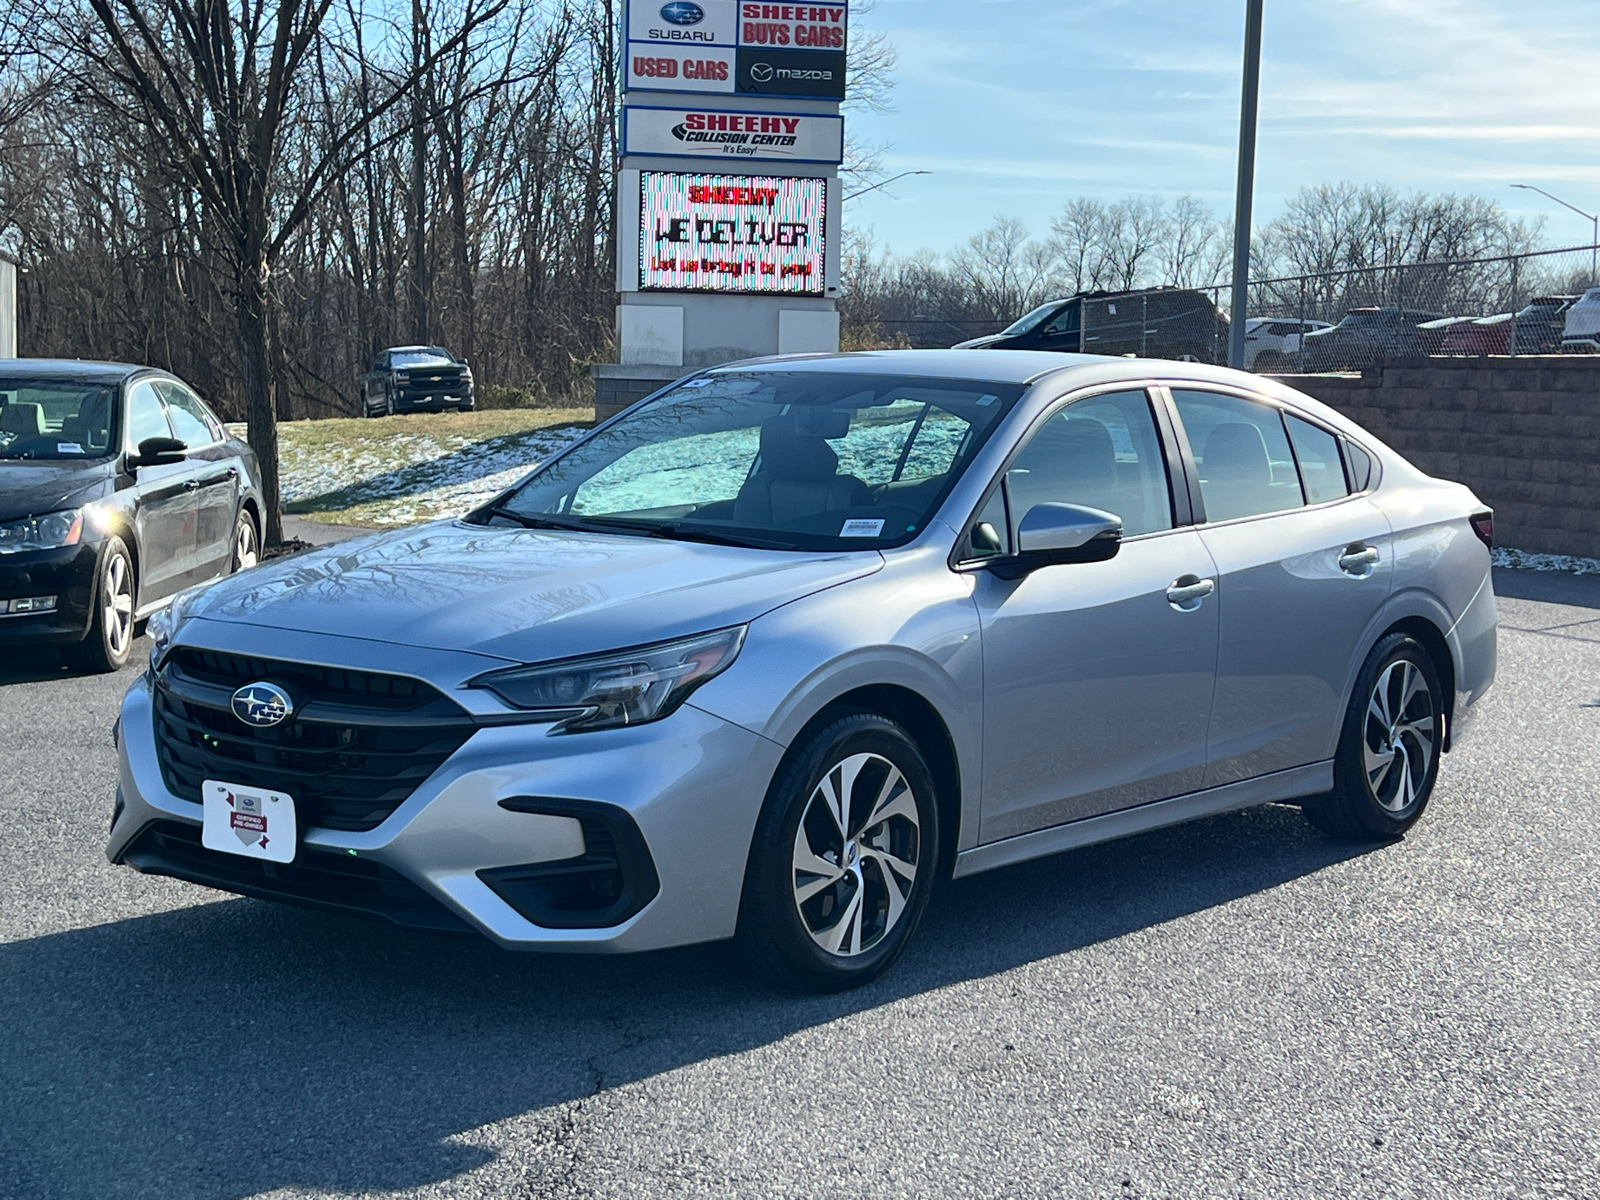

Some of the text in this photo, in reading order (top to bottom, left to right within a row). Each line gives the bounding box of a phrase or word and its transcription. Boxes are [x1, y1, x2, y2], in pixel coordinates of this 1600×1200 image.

[743, 4, 844, 22] SHEEHY
[648, 29, 715, 42] SUBARU
[743, 22, 843, 47] BUYS CARS
[633, 56, 729, 81] USED CARS
[776, 69, 833, 81] mazda
[685, 114, 801, 134] SHEEHY
[685, 131, 797, 147] COLLISION CENTER
[722, 145, 759, 156] It's Easy!
[688, 185, 779, 206] SHEEHY
[656, 216, 808, 246] WE DELIVER
[236, 814, 262, 824] CERTIFIED
